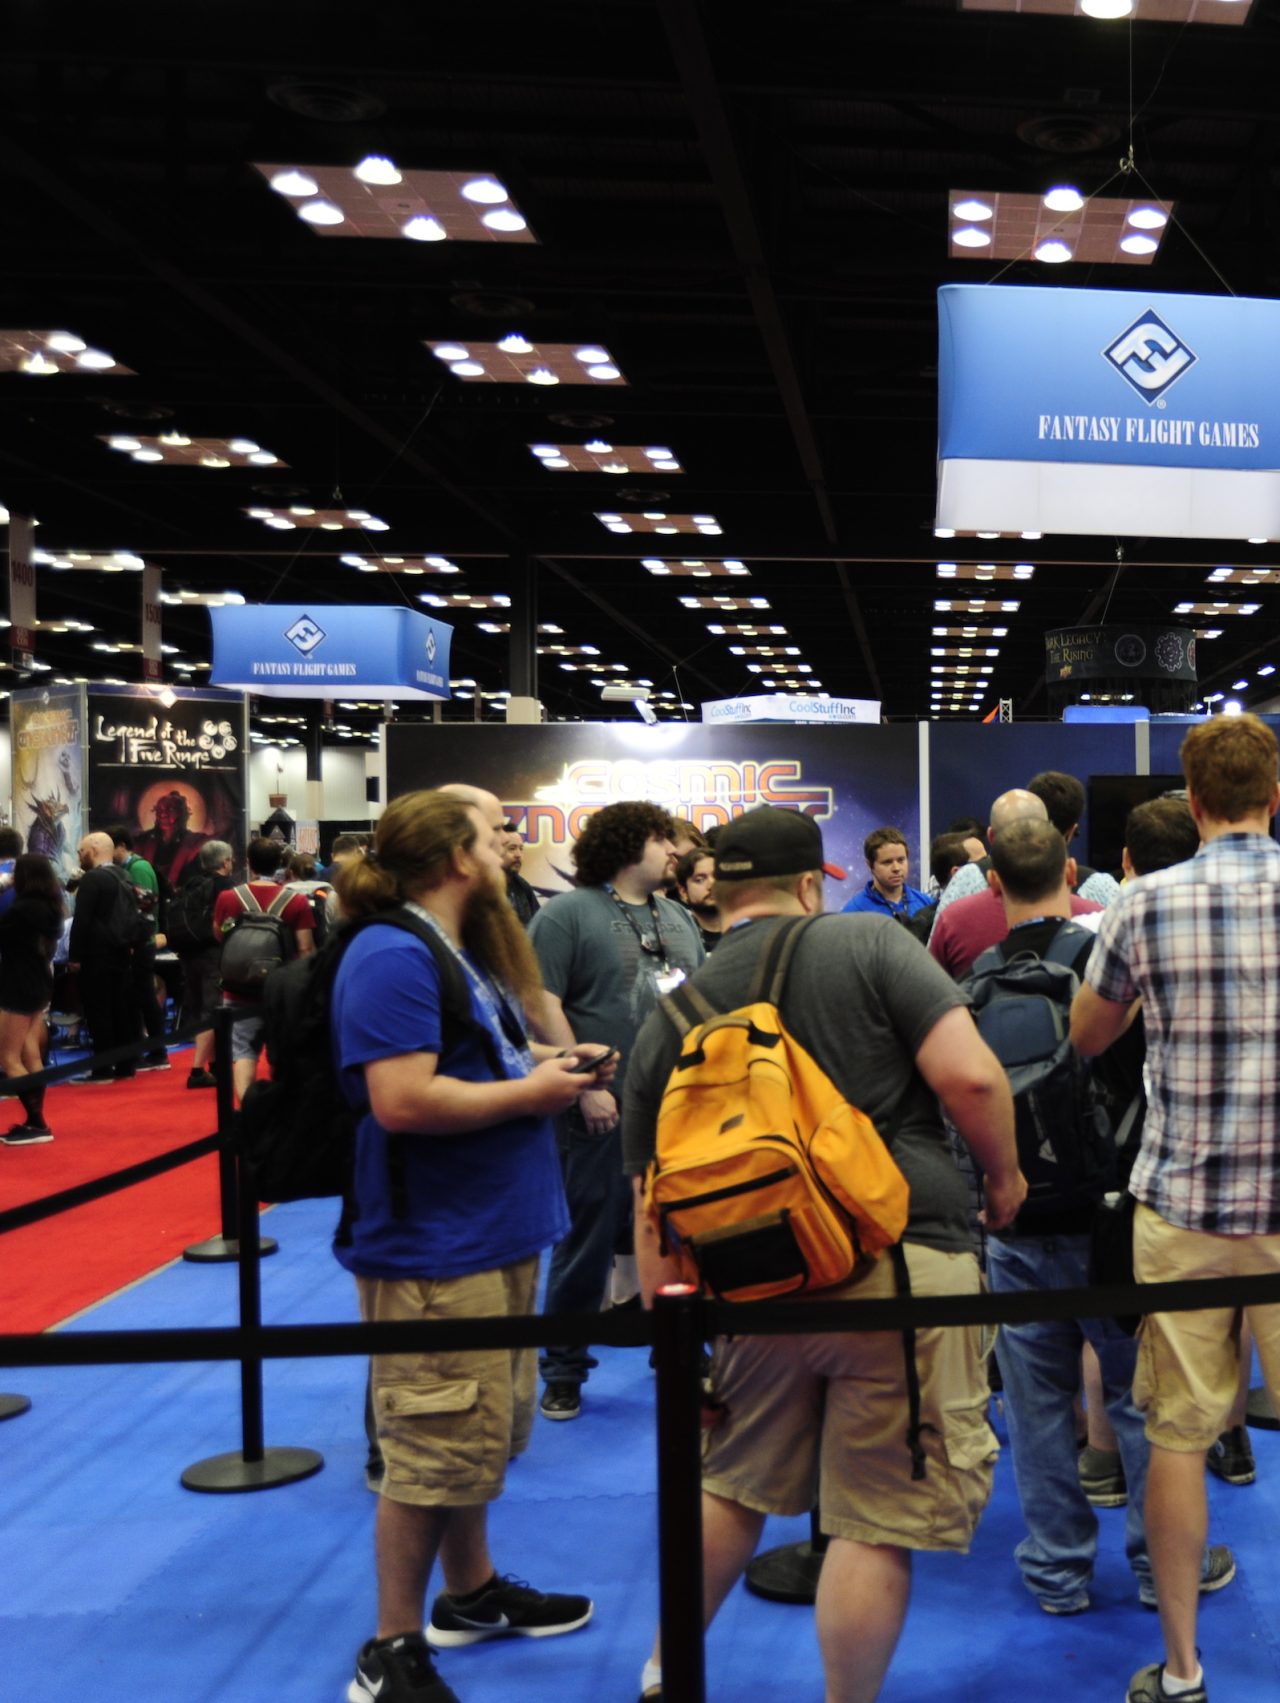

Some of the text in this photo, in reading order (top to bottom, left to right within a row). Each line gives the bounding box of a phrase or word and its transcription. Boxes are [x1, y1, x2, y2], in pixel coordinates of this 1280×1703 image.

[1038, 415, 1260, 448] FANTASY FLIGHT GAMES
[253, 662, 357, 676] FANTASY FLIGHT GAMES
[789, 701, 856, 715] CoolStuffInc
[96, 715, 158, 763] Legend
[161, 721, 174, 739] of
[176, 729, 196, 747] the
